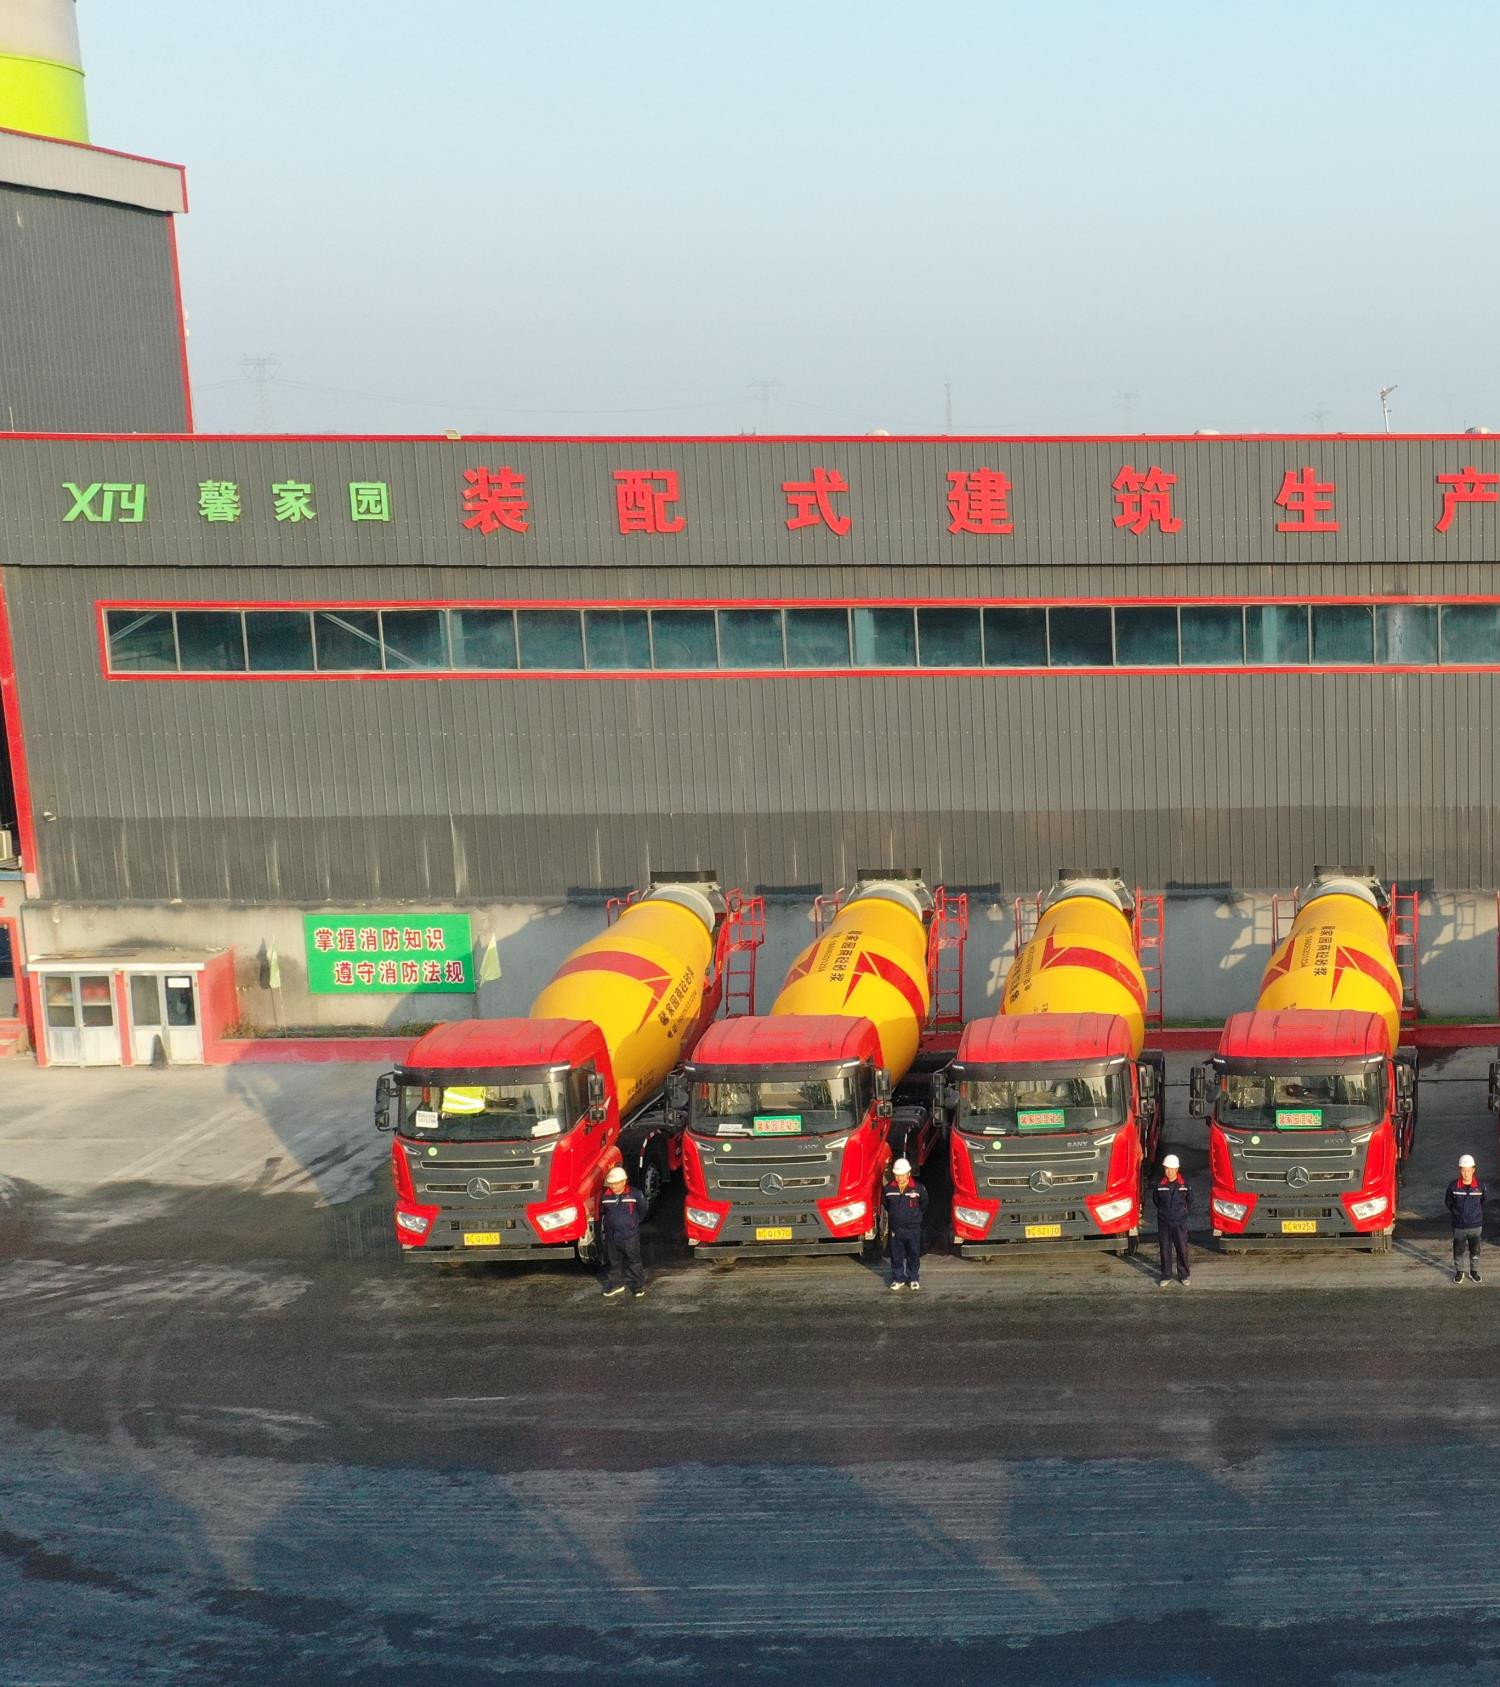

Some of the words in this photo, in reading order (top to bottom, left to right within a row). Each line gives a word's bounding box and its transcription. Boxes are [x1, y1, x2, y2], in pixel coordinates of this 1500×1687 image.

[198, 480, 392, 523] 馨家园
[315, 927, 447, 952] 掌握消防知识
[334, 960, 466, 985] 遵守消防法规
